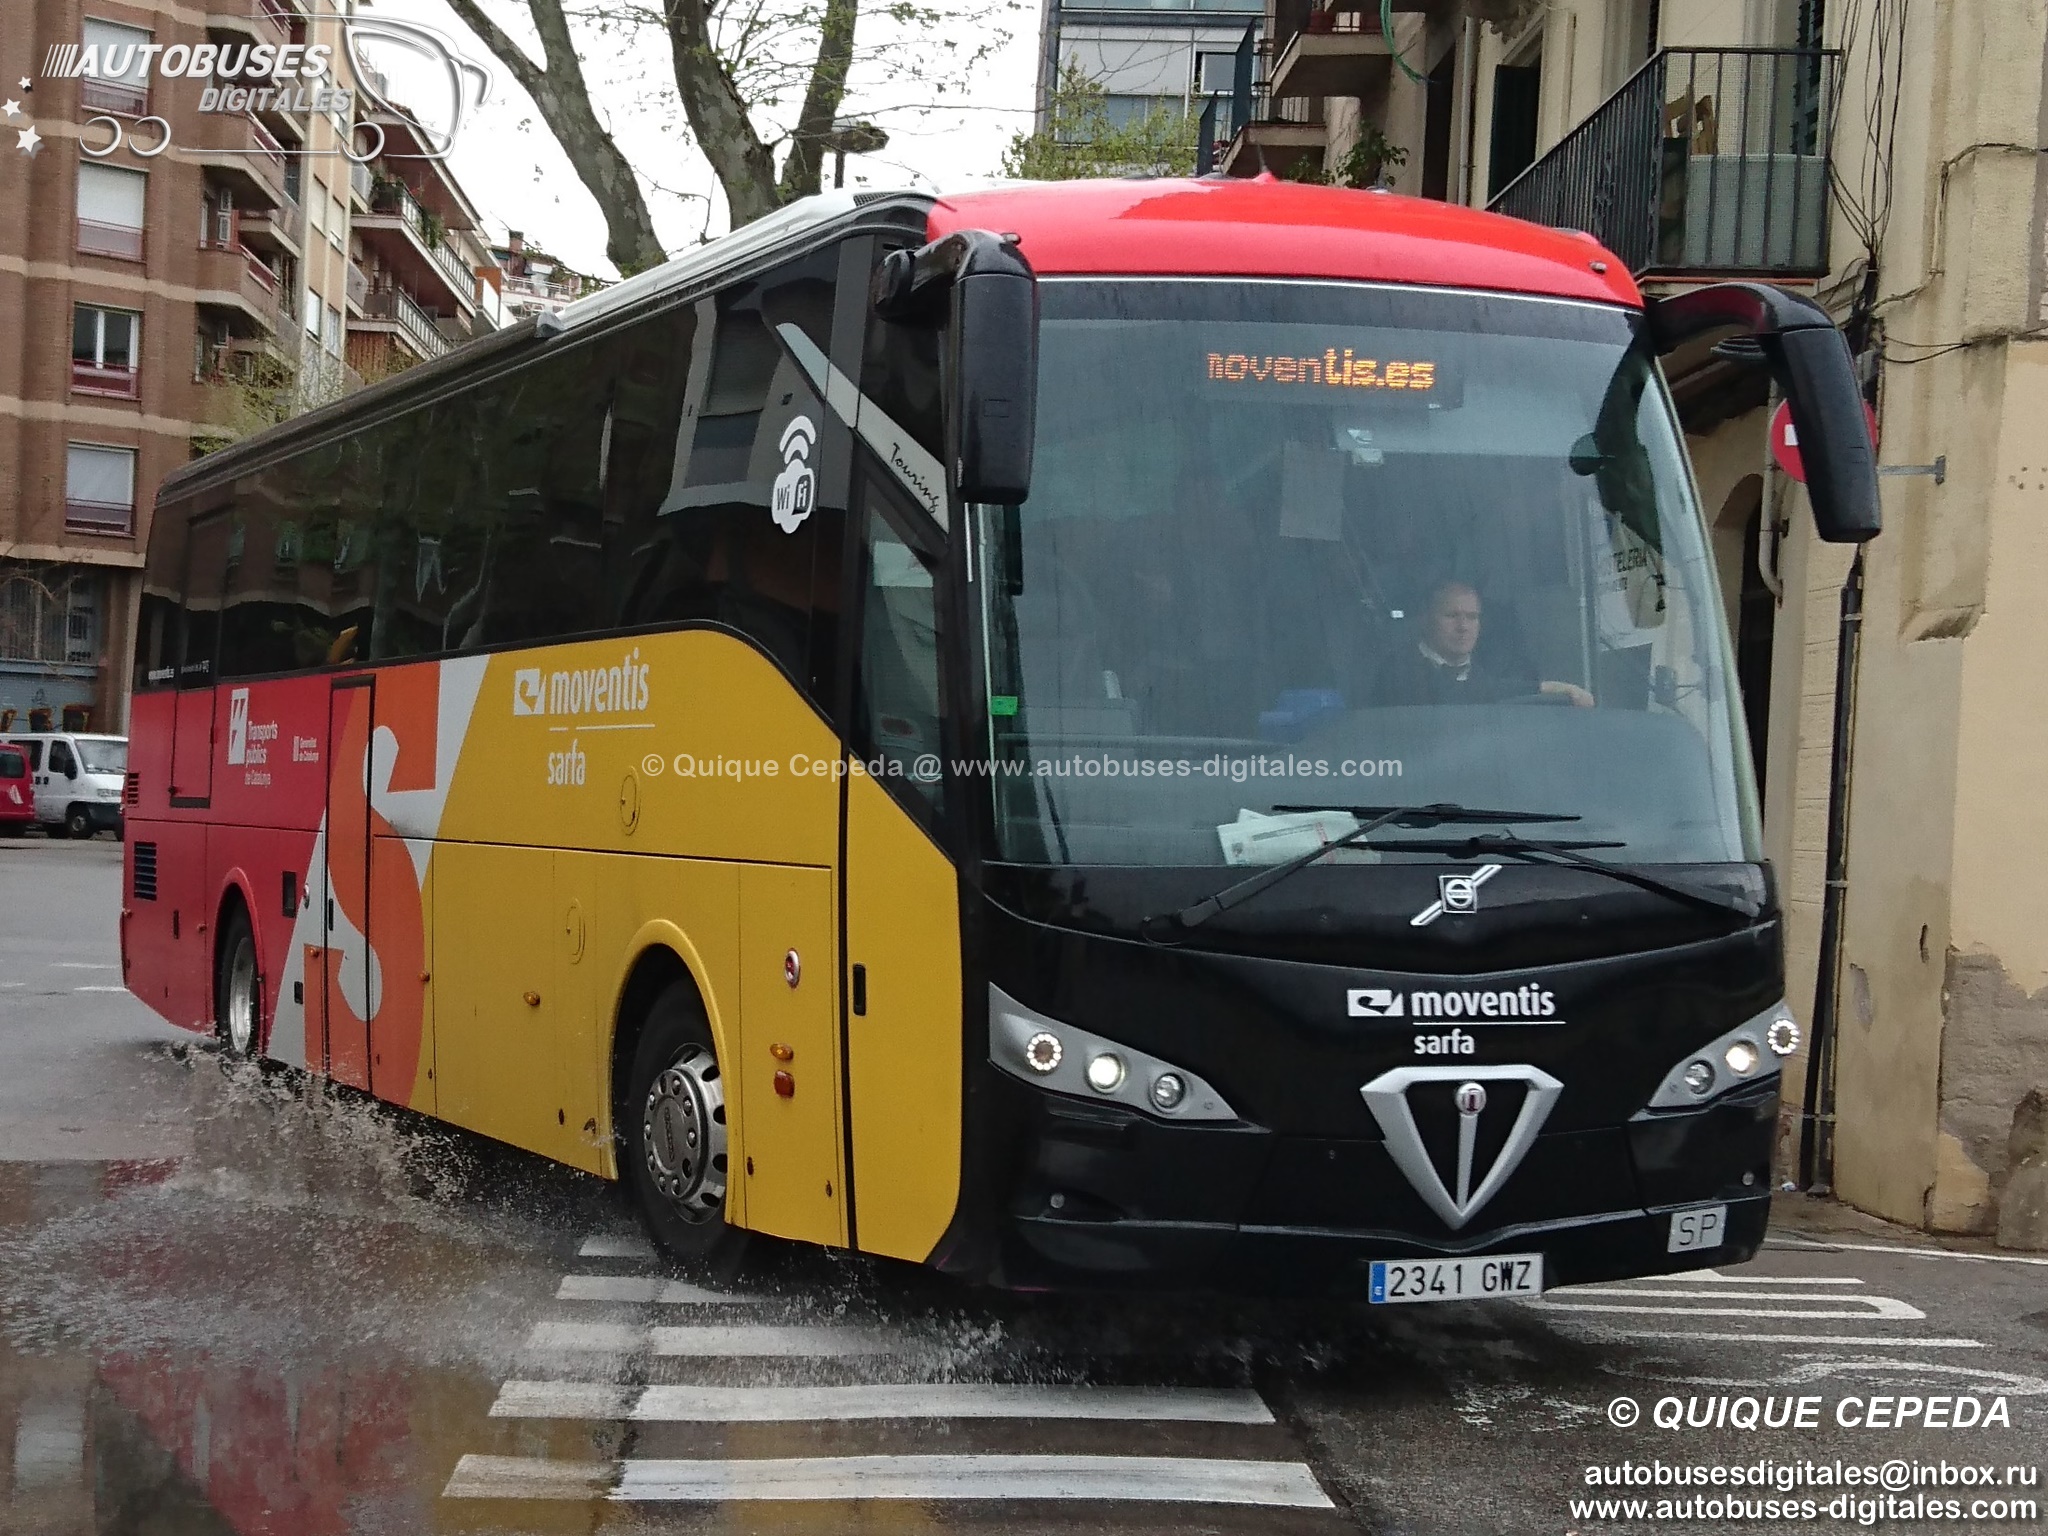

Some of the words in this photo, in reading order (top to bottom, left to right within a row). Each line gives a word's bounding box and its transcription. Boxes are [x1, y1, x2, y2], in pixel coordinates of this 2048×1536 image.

[892, 443, 940, 514] Touring
[549, 646, 650, 715] moventis
[547, 738, 586, 786] sarfa
[1410, 982, 1557, 1018] moventis
[1413, 1028, 1476, 1056] sarfa
[1678, 1213, 1718, 1247] SP
[1388, 1263, 1463, 1297] 2341
[1481, 1259, 1533, 1293] GWZ
